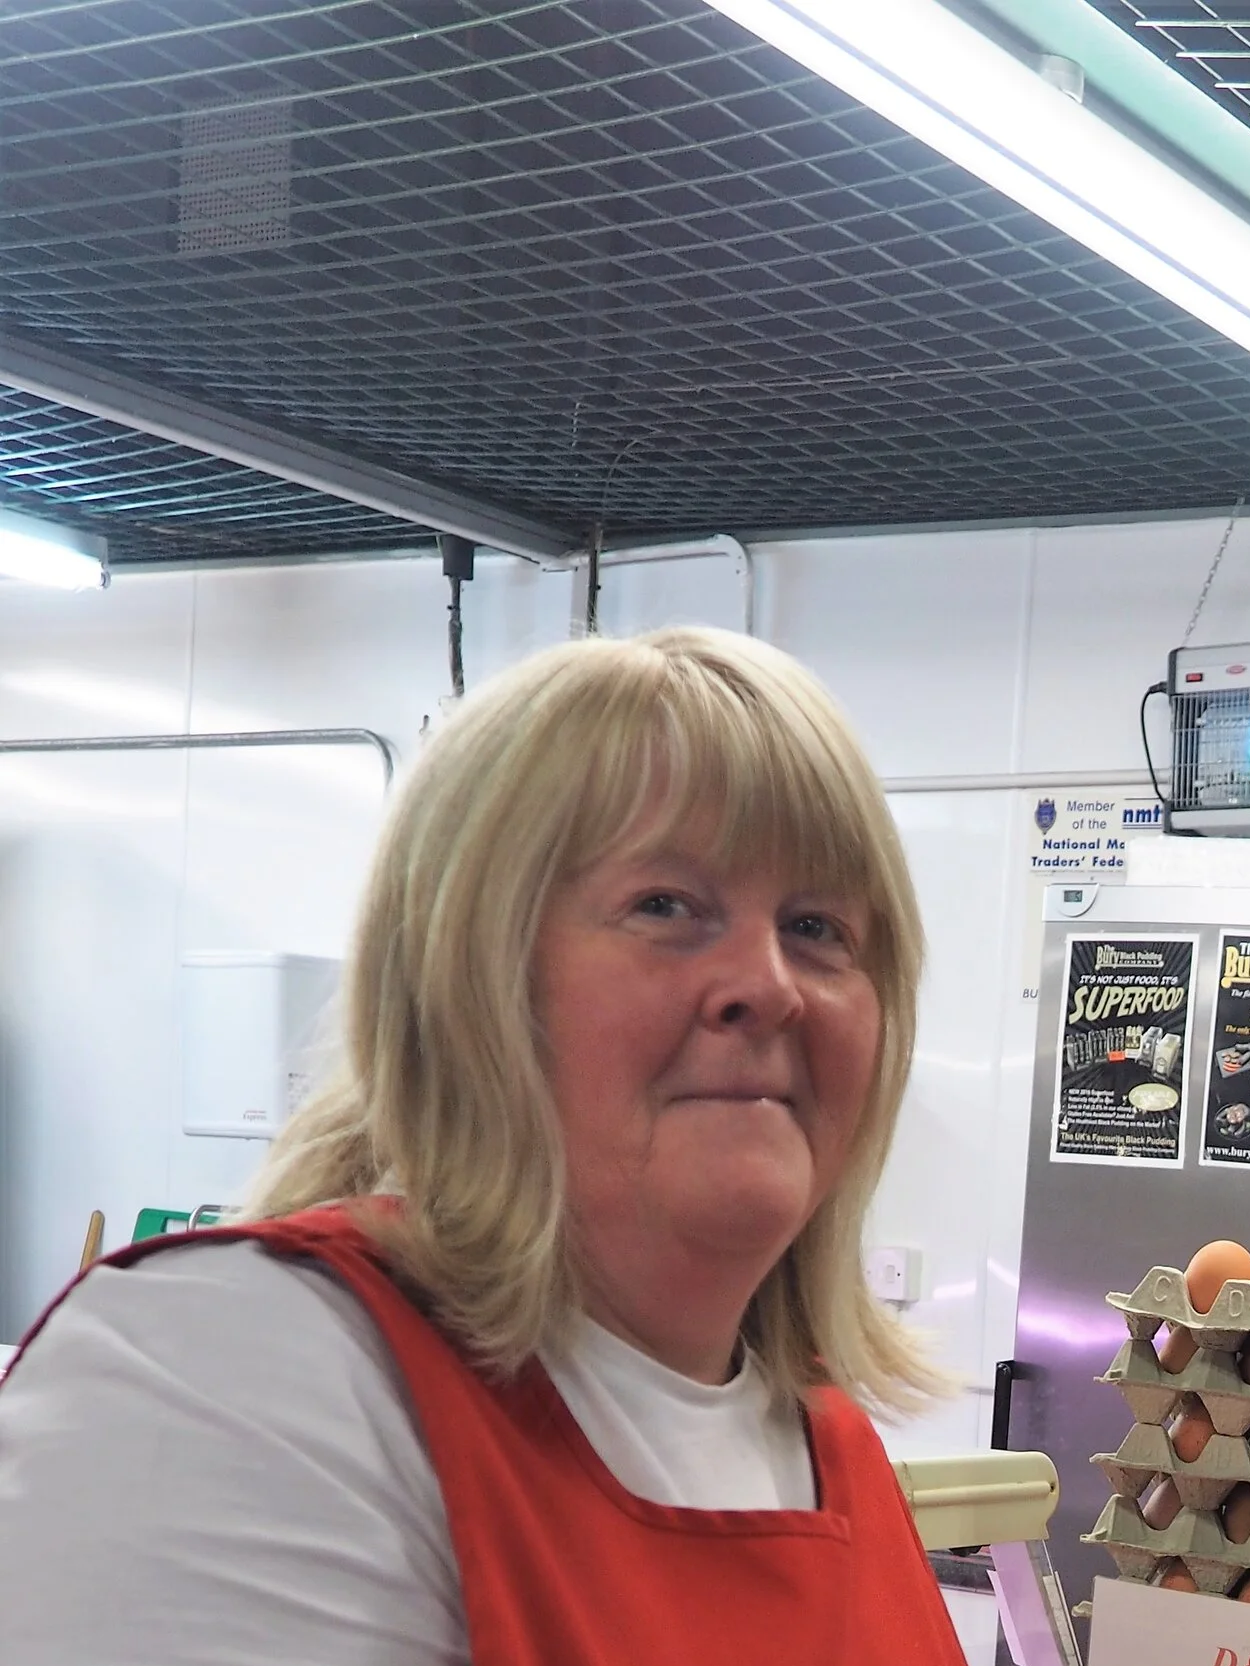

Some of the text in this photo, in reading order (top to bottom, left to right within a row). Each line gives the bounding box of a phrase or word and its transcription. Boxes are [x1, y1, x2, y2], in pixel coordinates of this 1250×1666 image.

[1067, 800, 1115, 811] Member
[1072, 818, 1107, 829] of the
[1043, 838, 1100, 849] National
[1031, 856, 1085, 867] Traders'
[1096, 946, 1120, 966] Bury
[1098, 975, 1114, 984] NOT
[1114, 976, 1134, 984] JUST
[1068, 985, 1184, 1025] SUPERFOOD
[1061, 1132, 1074, 1141] The
[1126, 1135, 1145, 1144] Black
[1146, 1136, 1176, 1147] Pudding
[1153, 1275, 1172, 1302] C
